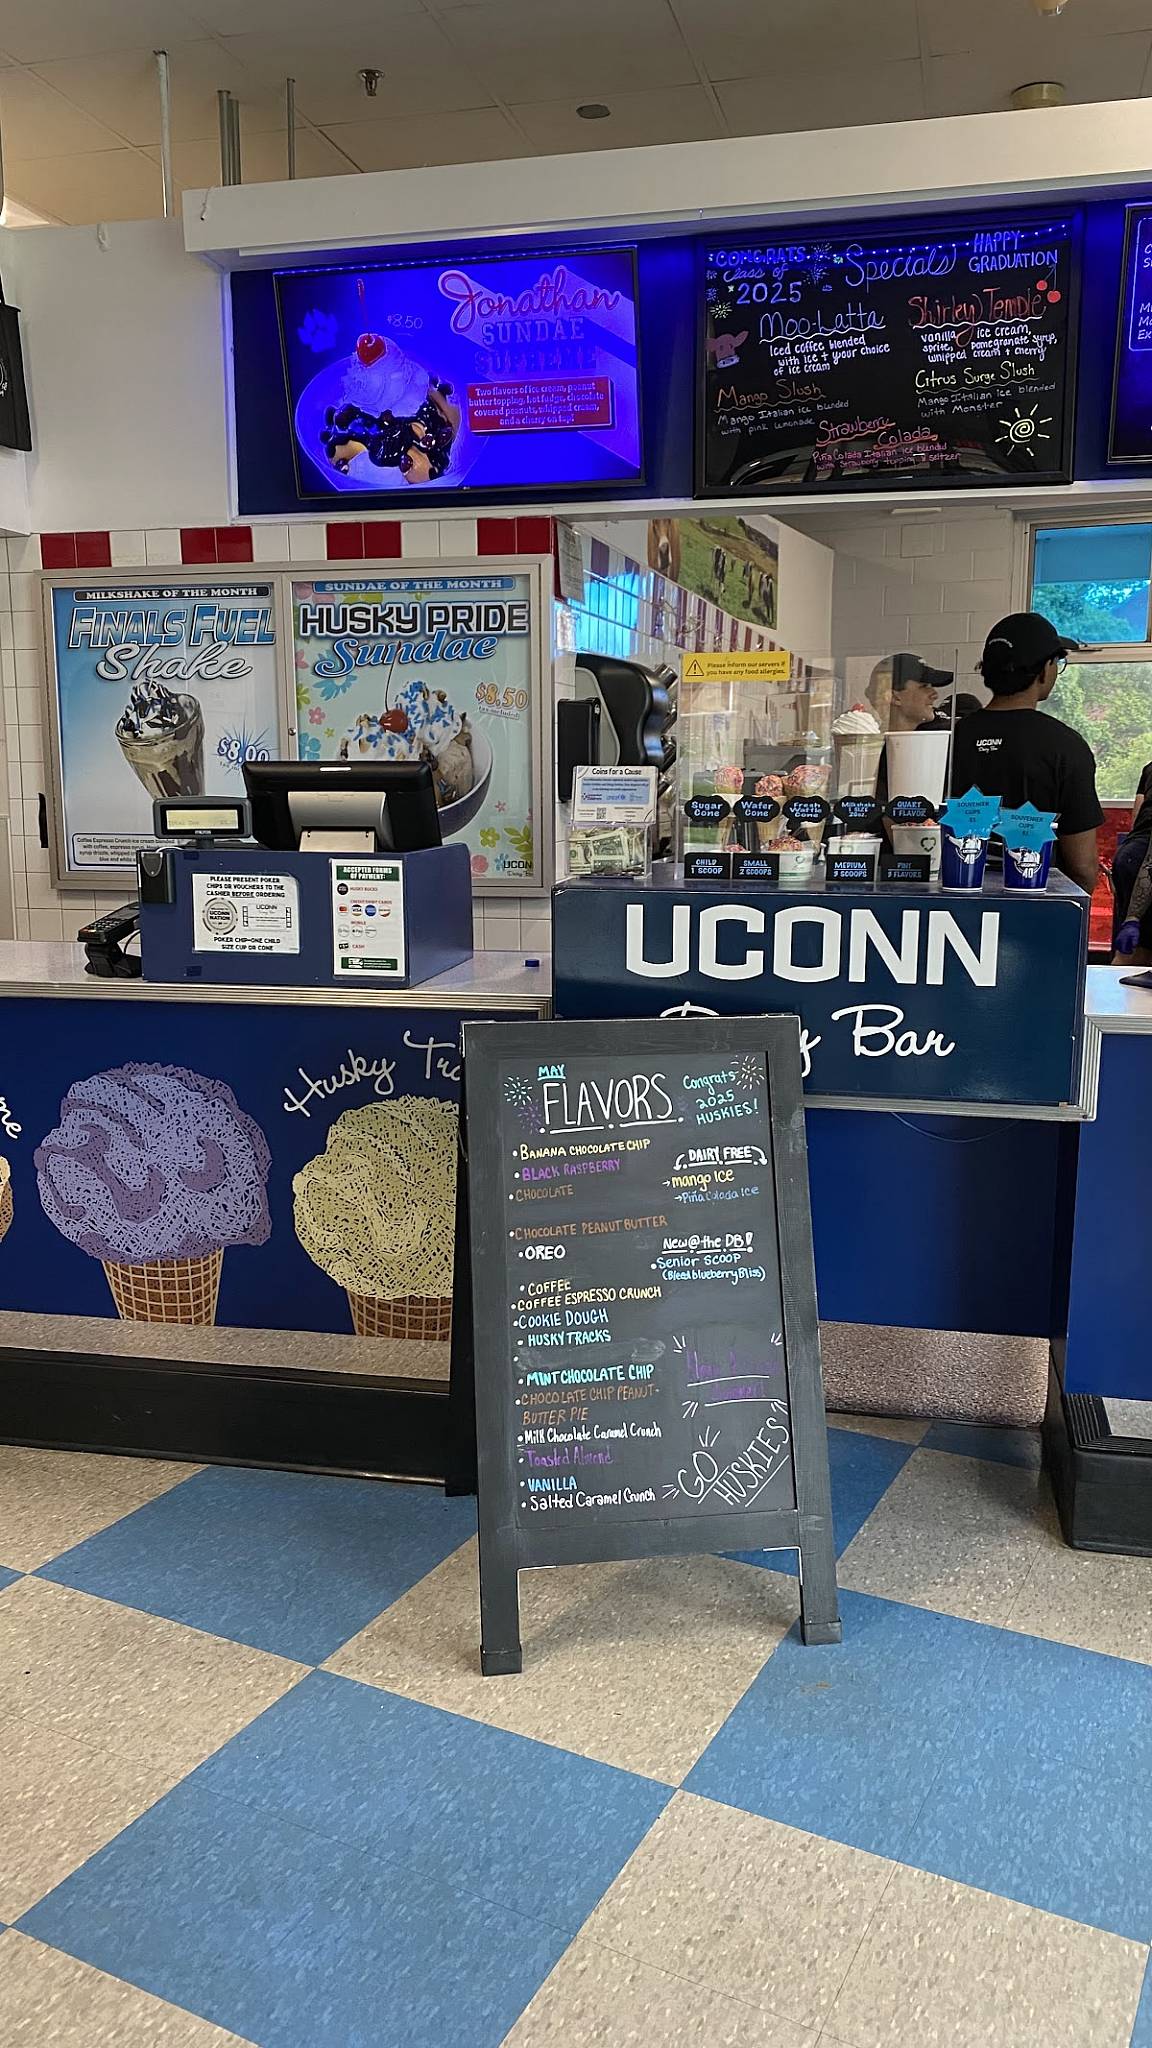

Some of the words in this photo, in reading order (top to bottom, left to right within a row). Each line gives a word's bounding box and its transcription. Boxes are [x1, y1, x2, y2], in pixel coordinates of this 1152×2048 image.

[974, 230, 1020, 253] HAPPY
[716, 246, 806, 267] CONGRATS
[969, 250, 1058, 273] GRADUATION
[772, 262, 789, 281] of
[438, 265, 623, 334] Jonathan
[737, 281, 803, 305] 2025
[983, 287, 1047, 321] Temple
[387, 313, 424, 329] $8.50
[481, 316, 584, 345] SUNDAE
[769, 341, 791, 357] Iced
[794, 340, 825, 355] coffee
[829, 334, 866, 351] blended
[921, 331, 957, 346] vanilla
[976, 325, 995, 340] ice
[998, 324, 1031, 340] cream,
[922, 342, 954, 356] sprite,
[971, 336, 1031, 354] pomegranate
[1032, 332, 1058, 350] syrup,
[782, 354, 804, 367] with
[808, 352, 824, 364] ice
[832, 346, 861, 365] your
[860, 340, 891, 356] choice
[927, 349, 967, 365] whipped
[972, 345, 1000, 359] cream
[1014, 342, 1048, 361] cherry
[793, 364, 806, 375] ice
[809, 360, 832, 373] cream
[915, 369, 957, 389] Citrus
[963, 366, 996, 385] Surge
[998, 360, 1035, 380] Slush
[717, 385, 768, 408] Mango
[776, 378, 823, 400] Slush
[917, 395, 949, 408] Mango
[951, 391, 993, 405] Italian
[995, 388, 1012, 400] ice
[717, 411, 755, 427] Mango
[758, 407, 795, 421] Italian
[920, 406, 946, 419] with
[952, 400, 1002, 414] Monster
[748, 421, 769, 436] pink
[816, 415, 890, 445] Strawberry
[877, 425, 932, 447] Colada
[85, 589, 160, 600] MILKSHAKE
[162, 588, 183, 599] OF
[185, 587, 209, 599] THE
[211, 585, 258, 598] MONTH
[324, 583, 386, 593] SUNDAE
[390, 582, 414, 591] OF
[417, 581, 443, 590] THE
[446, 580, 502, 590] MONTH
[69, 606, 187, 648] FINALS
[190, 602, 277, 647] FUEL
[300, 603, 421, 636] HUSKY
[426, 602, 529, 635] PRIDE
[96, 641, 253, 681] Shake
[315, 629, 499, 678] Sundae
[759, 660, 780, 668] servers
[475, 682, 529, 710] $8.50
[976, 738, 1003, 747] UCONN
[592, 767, 608, 776] Coins
[625, 767, 643, 776] Cause
[691, 802, 723, 813] Sugar
[693, 809, 720, 818] Cone
[741, 802, 774, 812] Wafer
[744, 809, 769, 818] Cone
[898, 810, 927, 818] FLAVOR
[834, 861, 867, 869] MEDIUM
[840, 870, 868, 878] SCOOPS
[1022, 868, 1034, 879] 40
[626, 903, 999, 987] UCONN
[831, 1003, 956, 1058] Bar
[539, 1063, 566, 1078] MAY
[283, 1049, 396, 1117] Husky
[683, 1070, 736, 1096] Congrats
[542, 1072, 673, 1126] FLAVORS
[696, 1089, 735, 1110] 2025
[696, 1098, 759, 1125] HUSKIES!
[520, 1143, 567, 1161] BANANA
[569, 1141, 626, 1157] CHOCOLATE
[626, 1138, 651, 1151] CHIP
[688, 1146, 719, 1162] DAIRY
[722, 1145, 753, 1160] FREE
[521, 1166, 561, 1182] BLACK
[563, 1158, 621, 1177] RASPBERRY
[515, 1184, 575, 1202] CHOCOLATE
[671, 1173, 712, 1192] mango
[682, 1190, 705, 1204] Piña
[706, 1190, 740, 1201] Colada
[514, 1223, 578, 1241] CHOCOLATE
[581, 1219, 622, 1235] PEANUT
[623, 1215, 668, 1231] BUTTER
[525, 1243, 567, 1260] OREO
[656, 1255, 700, 1269] Senior
[517, 1295, 562, 1312] COFFEE
[565, 1287, 617, 1306] ESPRESSO
[619, 1286, 663, 1301] CRUNCH
[528, 1279, 571, 1298] COFFEE
[519, 1312, 562, 1330] COOKIE
[565, 1308, 609, 1327] DOUGH
[528, 1331, 565, 1348] HUSKY
[566, 1329, 612, 1346] TRACKS
[527, 1370, 560, 1387] MINT
[560, 1365, 626, 1385] CHOCOLATE
[628, 1363, 656, 1380] CHIP
[521, 1387, 588, 1406] CHOCOLATE
[590, 1386, 617, 1402] CHIP
[617, 1383, 656, 1401] PEANUT
[523, 1409, 567, 1425] BUTTER
[570, 1406, 590, 1421] PIE
[524, 1428, 546, 1445] Milk
[546, 1426, 591, 1443] Chocolate
[594, 1422, 630, 1440] Caramel
[630, 1421, 662, 1438] Crunch
[525, 1447, 570, 1468] Toasted
[572, 1445, 614, 1465] Almond
[712, 1416, 790, 1506] HUSKIES
[528, 1475, 578, 1492] VANILLA
[676, 1450, 719, 1499] GO
[530, 1492, 575, 1512] Salted
[576, 1489, 623, 1508] Caramel
[623, 1486, 656, 1504] Crunch
